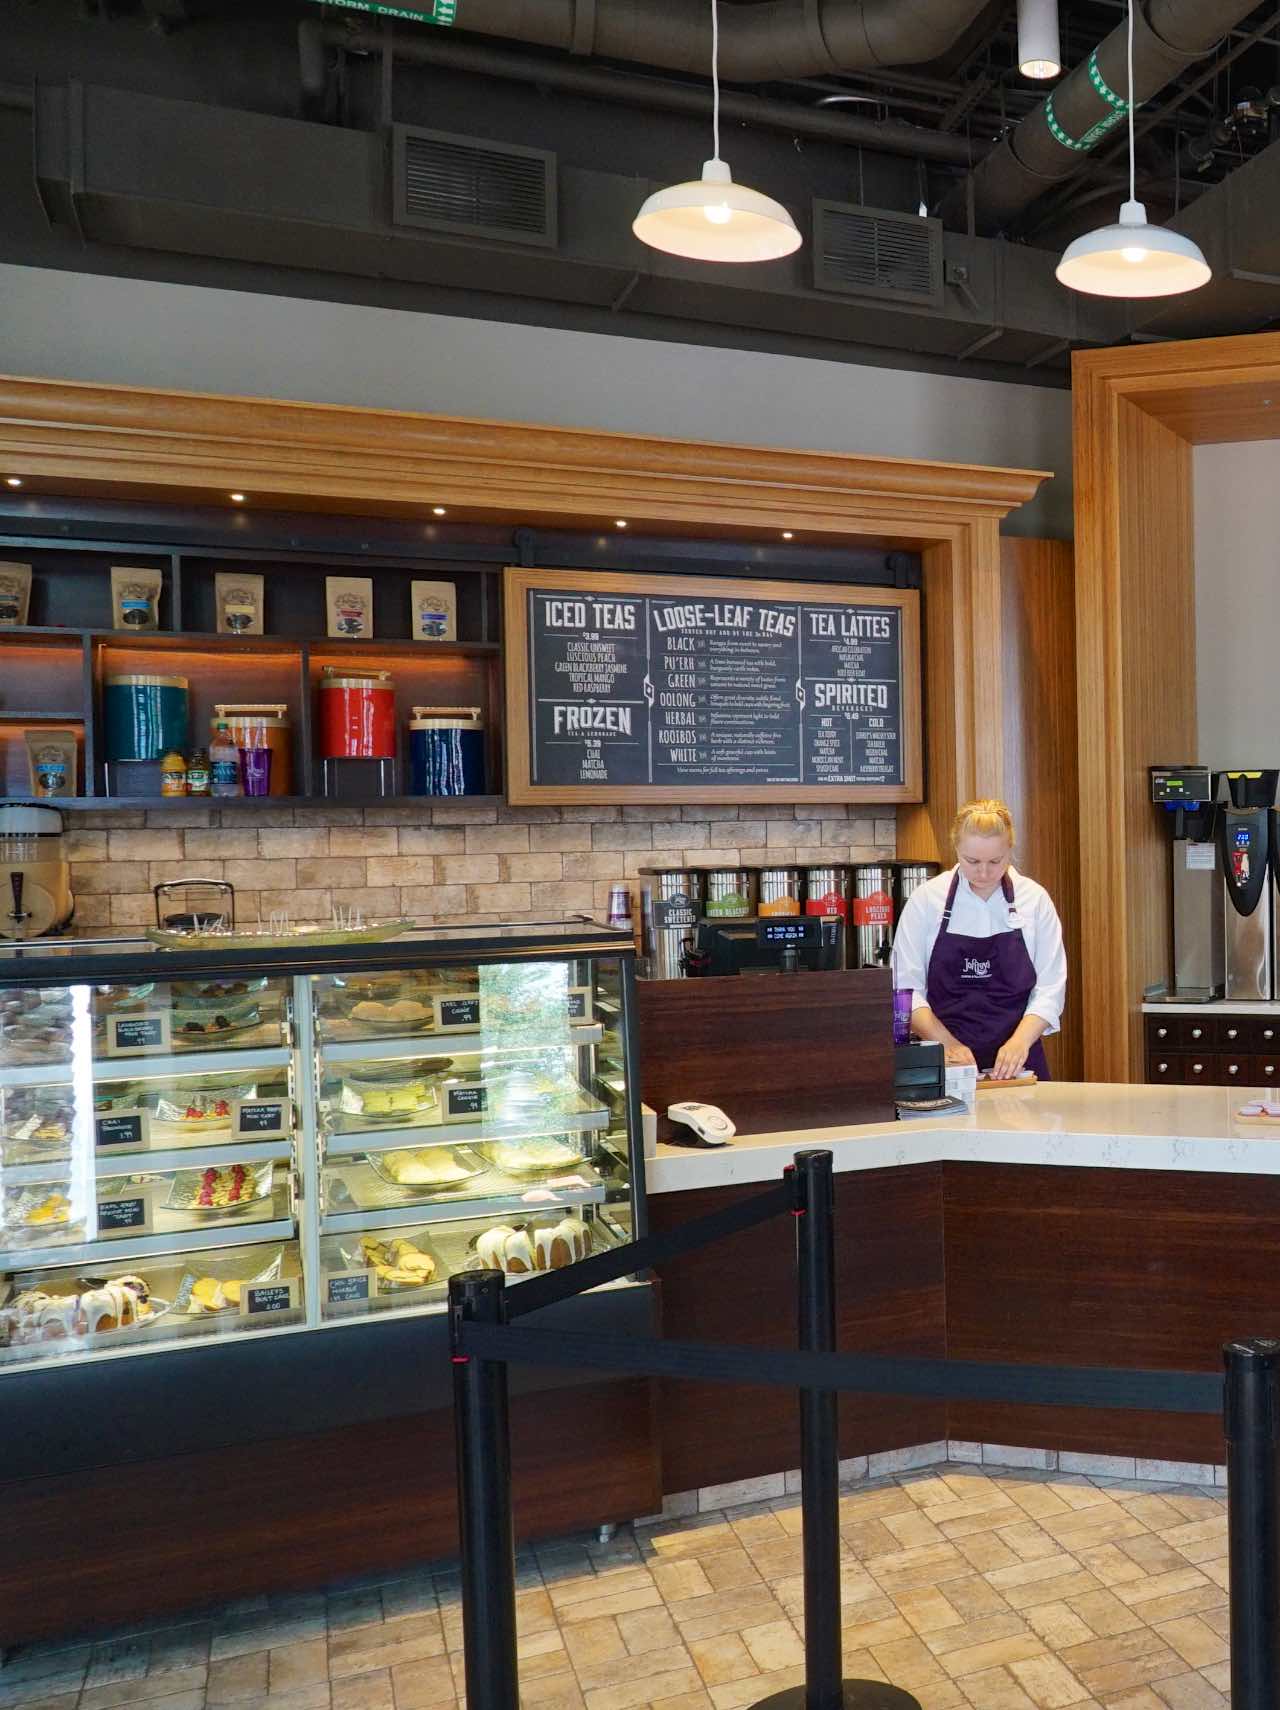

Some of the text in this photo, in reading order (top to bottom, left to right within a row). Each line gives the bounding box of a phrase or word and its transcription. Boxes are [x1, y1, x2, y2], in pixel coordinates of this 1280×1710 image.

[378, 6, 423, 21] DRAIN
[545, 601, 636, 630] ICED TEAS
[653, 604, 796, 637] LOOSE-LEAF TEAS
[810, 614, 890, 638] TEA LATTES
[667, 636, 695, 651] BLACK
[597, 653, 616, 662] PEACH
[664, 656, 695, 671] PU'ERH
[668, 673, 695, 688] GREEN
[659, 692, 696, 708] OOLONG
[815, 683, 888, 709] SPIRITED
[554, 705, 632, 736] FROZEN
[665, 711, 696, 726] HERBAL
[659, 729, 697, 744] ROOIBOS
[586, 749, 601, 759] CHAI
[670, 748, 697, 762] WHITE
[668, 908, 692, 917] CLASSIC
